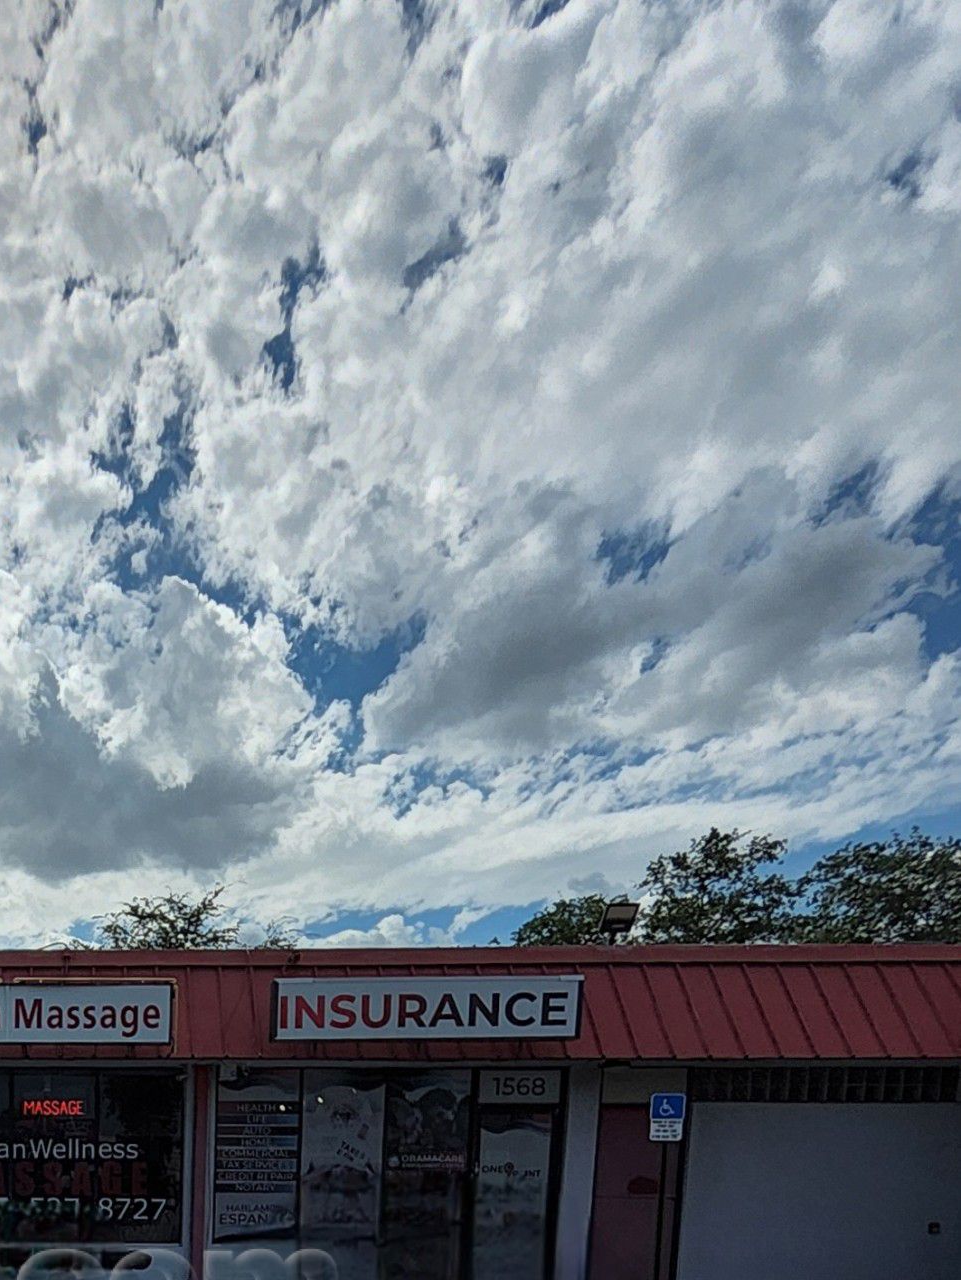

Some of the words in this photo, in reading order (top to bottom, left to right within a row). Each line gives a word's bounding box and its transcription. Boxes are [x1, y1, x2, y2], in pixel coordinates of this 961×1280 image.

[279, 991, 569, 1030] INSURANCE
[13, 997, 161, 1037] Massage
[492, 1076, 546, 1096] 1568
[23, 1099, 85, 1116] MASSAGE
[236, 1103, 276, 1112] HEALTH
[242, 1127, 272, 1135] AUTO
[222, 1149, 290, 1158] COMMERCIAL
[401, 1154, 463, 1163] OBAMACARE
[222, 1160, 239, 1169] TAX
[218, 1172, 254, 1181] CREDIT
[235, 1183, 276, 1191] NOTARY
[98, 1197, 167, 1220] 8727
